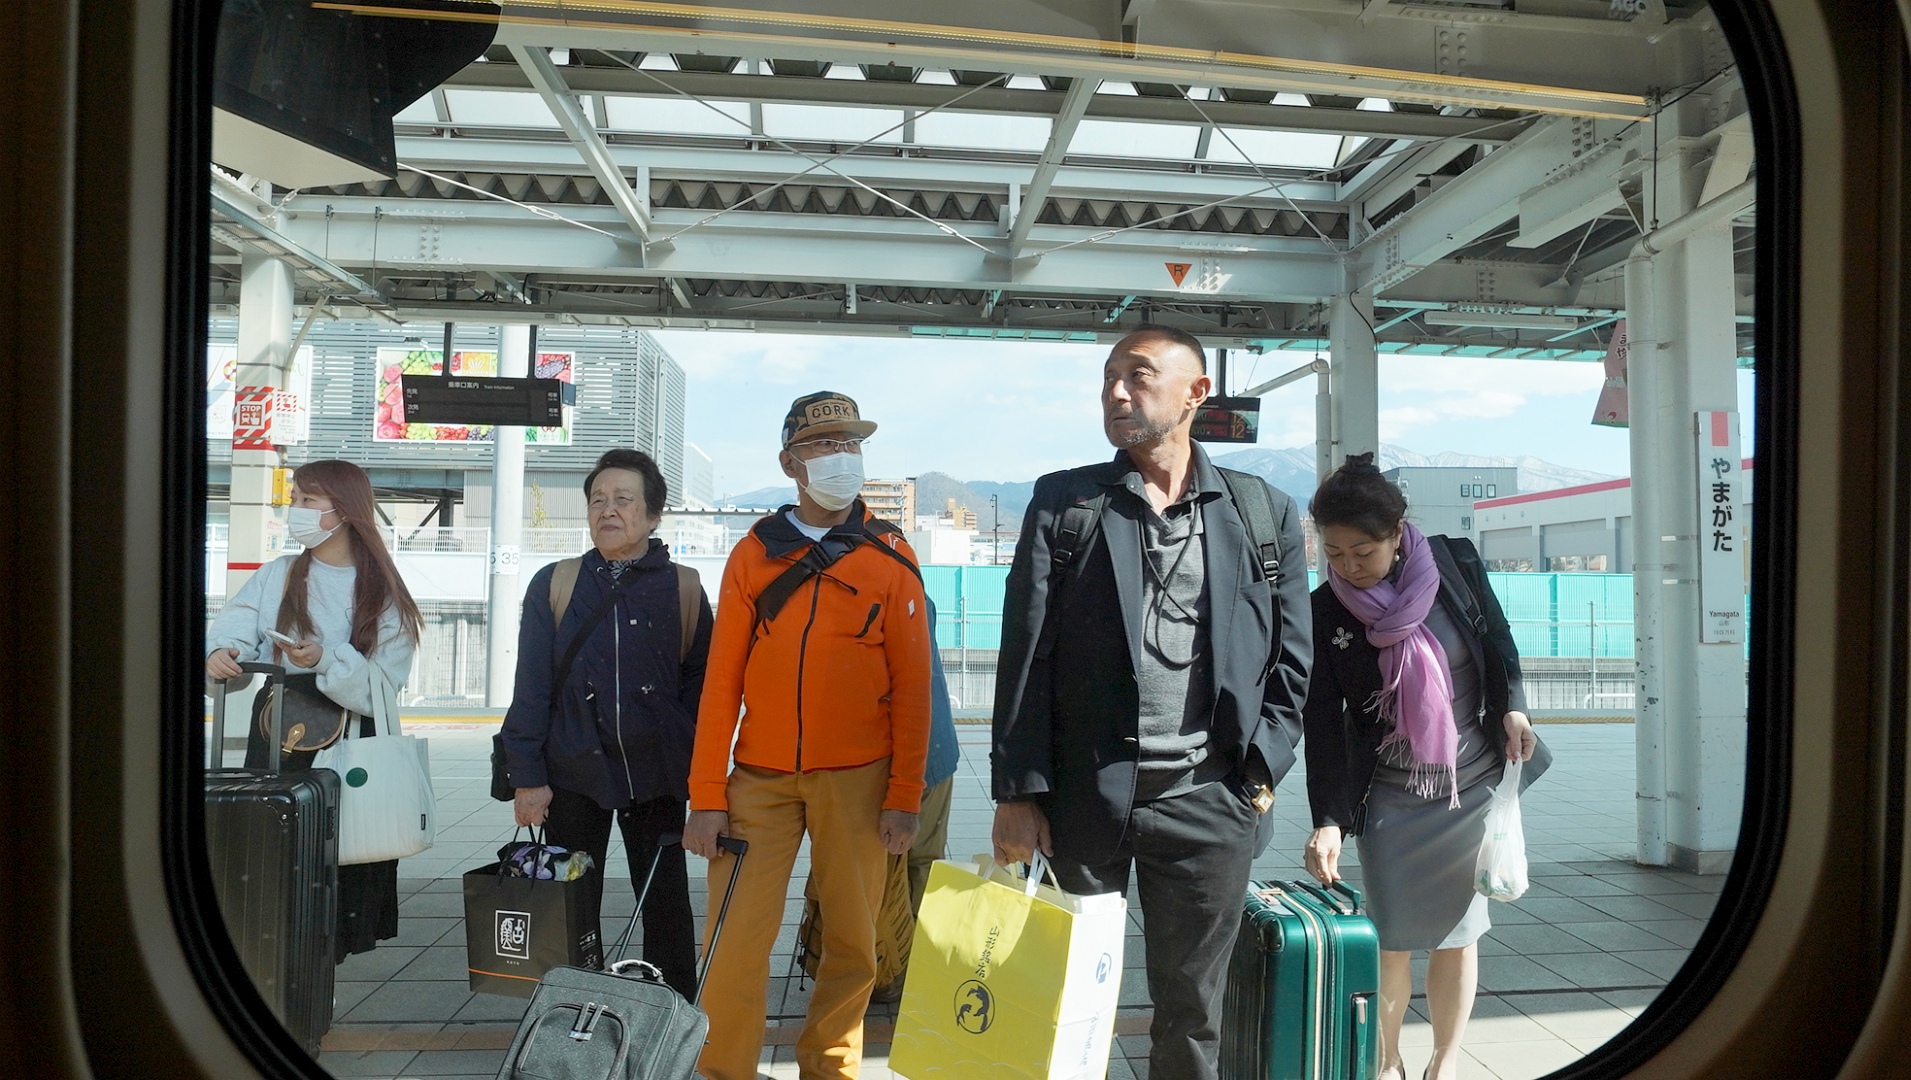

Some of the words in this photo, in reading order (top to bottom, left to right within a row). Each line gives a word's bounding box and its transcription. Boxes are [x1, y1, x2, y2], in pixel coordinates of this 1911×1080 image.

[1174, 265, 1184, 276] R
[812, 405, 850, 419] CORK
[1231, 425, 1246, 439] 12
[1711, 457, 1733, 552] やまがた
[501, 552, 519, 565] 35
[1709, 610, 1740, 619] Yamagata
